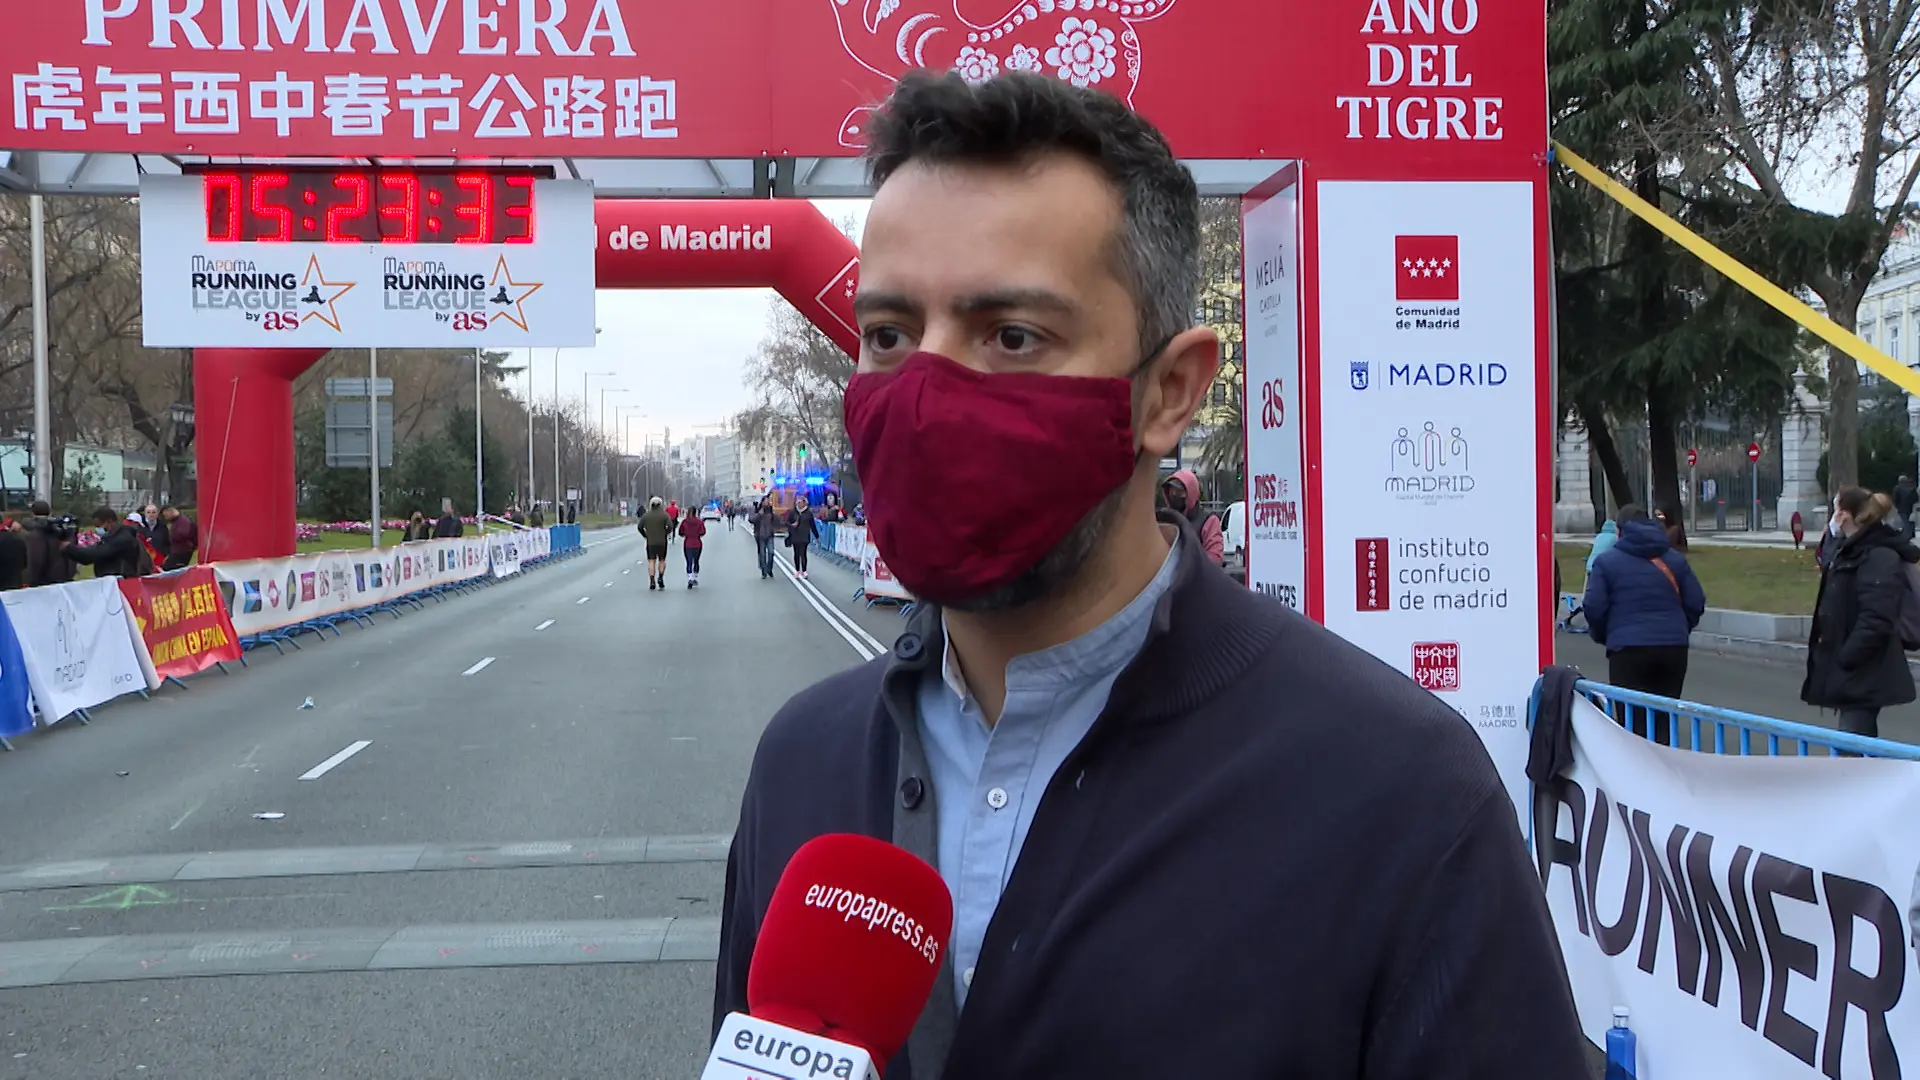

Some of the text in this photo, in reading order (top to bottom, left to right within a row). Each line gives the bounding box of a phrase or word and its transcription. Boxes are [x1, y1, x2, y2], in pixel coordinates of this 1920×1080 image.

[82, 0, 637, 56] PRIMAVERA
[1367, 43, 1472, 87] DEL
[12, 62, 678, 138] 虎年西中春节公路跑
[1336, 96, 1504, 140] TIGRE
[204, 174, 537, 244] 05:23:33
[608, 225, 649, 250] de
[660, 224, 772, 250] Madrid
[192, 272, 297, 290] RUNNING
[384, 274, 485, 290] RUNNING
[192, 290, 298, 310] LEAGUE
[384, 290, 486, 310] LEAGUE
[1395, 305, 1460, 316] Comunidad
[245, 311, 299, 331] by as
[435, 311, 488, 331] by as
[1395, 319, 1460, 330] de Madrid
[1389, 362, 1507, 386] MADRID
[1262, 377, 1284, 430] as
[1384, 475, 1475, 492] MADRID
[1399, 537, 1489, 558] instituto
[1399, 562, 1491, 584] confucio
[1399, 587, 1508, 610] de madrid
[1478, 719, 1518, 729] MADRID
[804, 882, 940, 965] europapress.es
[1532, 774, 1915, 1080] RUNNER
[733, 1028, 854, 1080] europa
